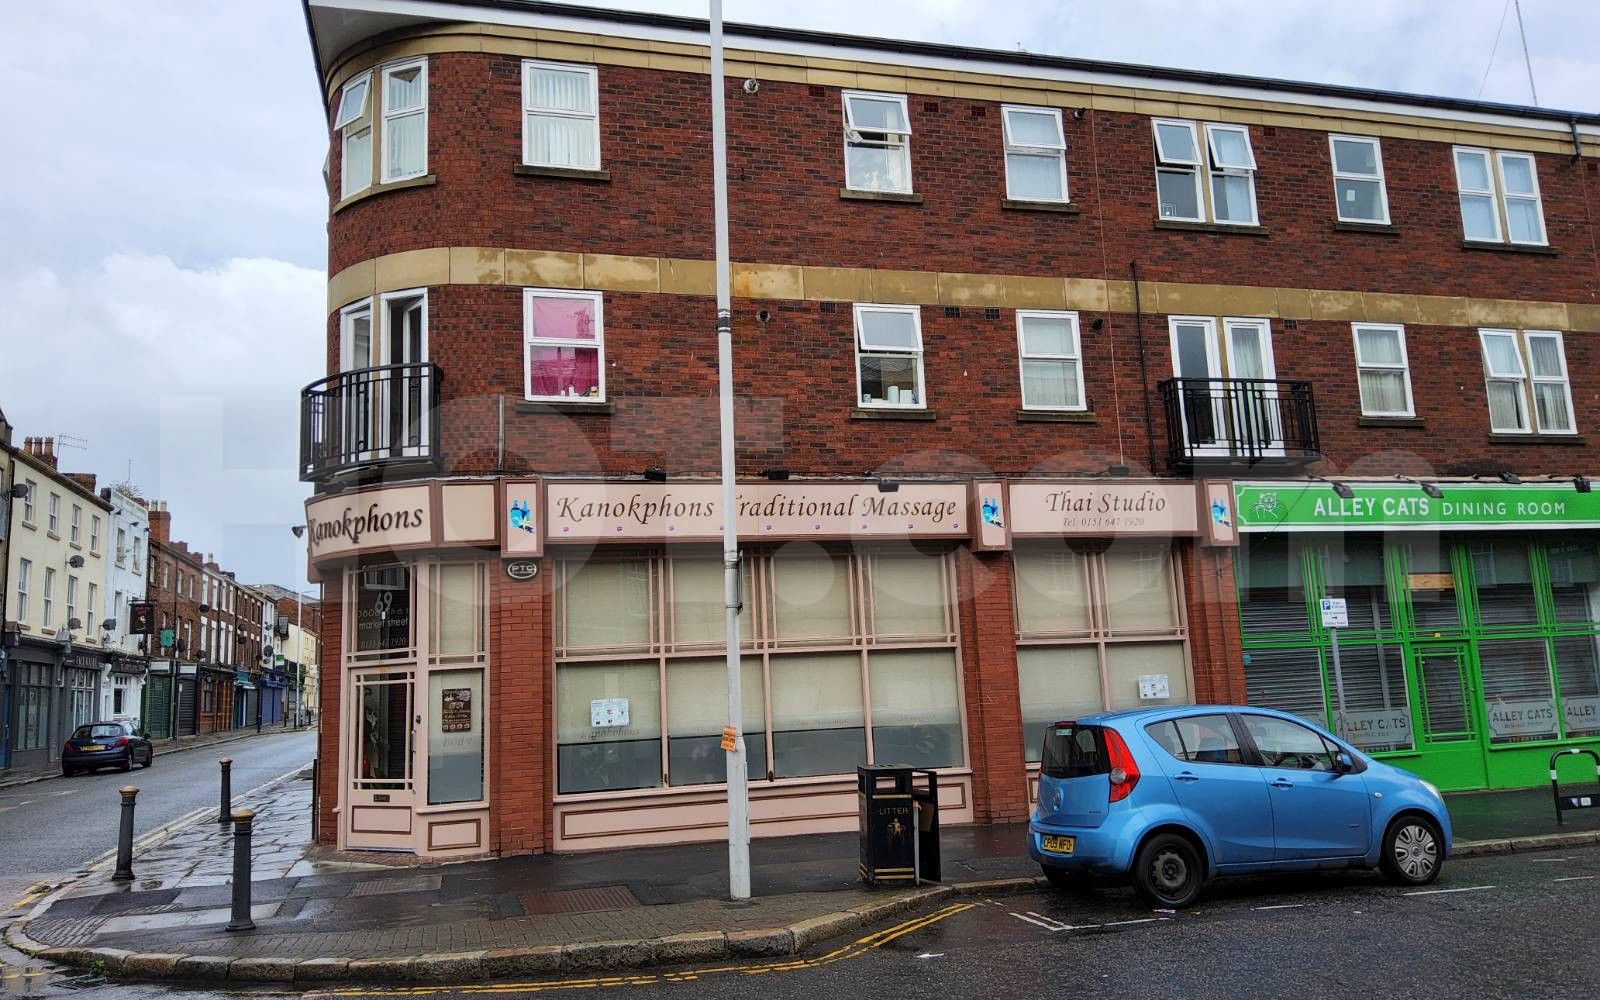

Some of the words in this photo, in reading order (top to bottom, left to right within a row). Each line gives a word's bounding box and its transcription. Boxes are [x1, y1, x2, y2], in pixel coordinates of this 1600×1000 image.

[557, 494, 715, 524] Kanokphons
[722, 494, 859, 517] raditional
[861, 496, 956, 523] Massage
[1046, 490, 1093, 512] Thai
[1097, 490, 1166, 513] Studio
[1313, 497, 1376, 517] ALLEY
[1382, 497, 1430, 517] CATS
[1442, 502, 1507, 516] DINING
[1517, 502, 1566, 516] ROOM
[309, 502, 424, 547] Kanokphons
[1105, 517, 1121, 527] 647
[1125, 517, 1145, 527] 1920
[374, 591, 393, 613] 69
[1492, 711, 1524, 723] ALLEY
[1527, 708, 1553, 721] CATS
[1567, 704, 1598, 718] ALLEY
[879, 807, 909, 816] LITTER
